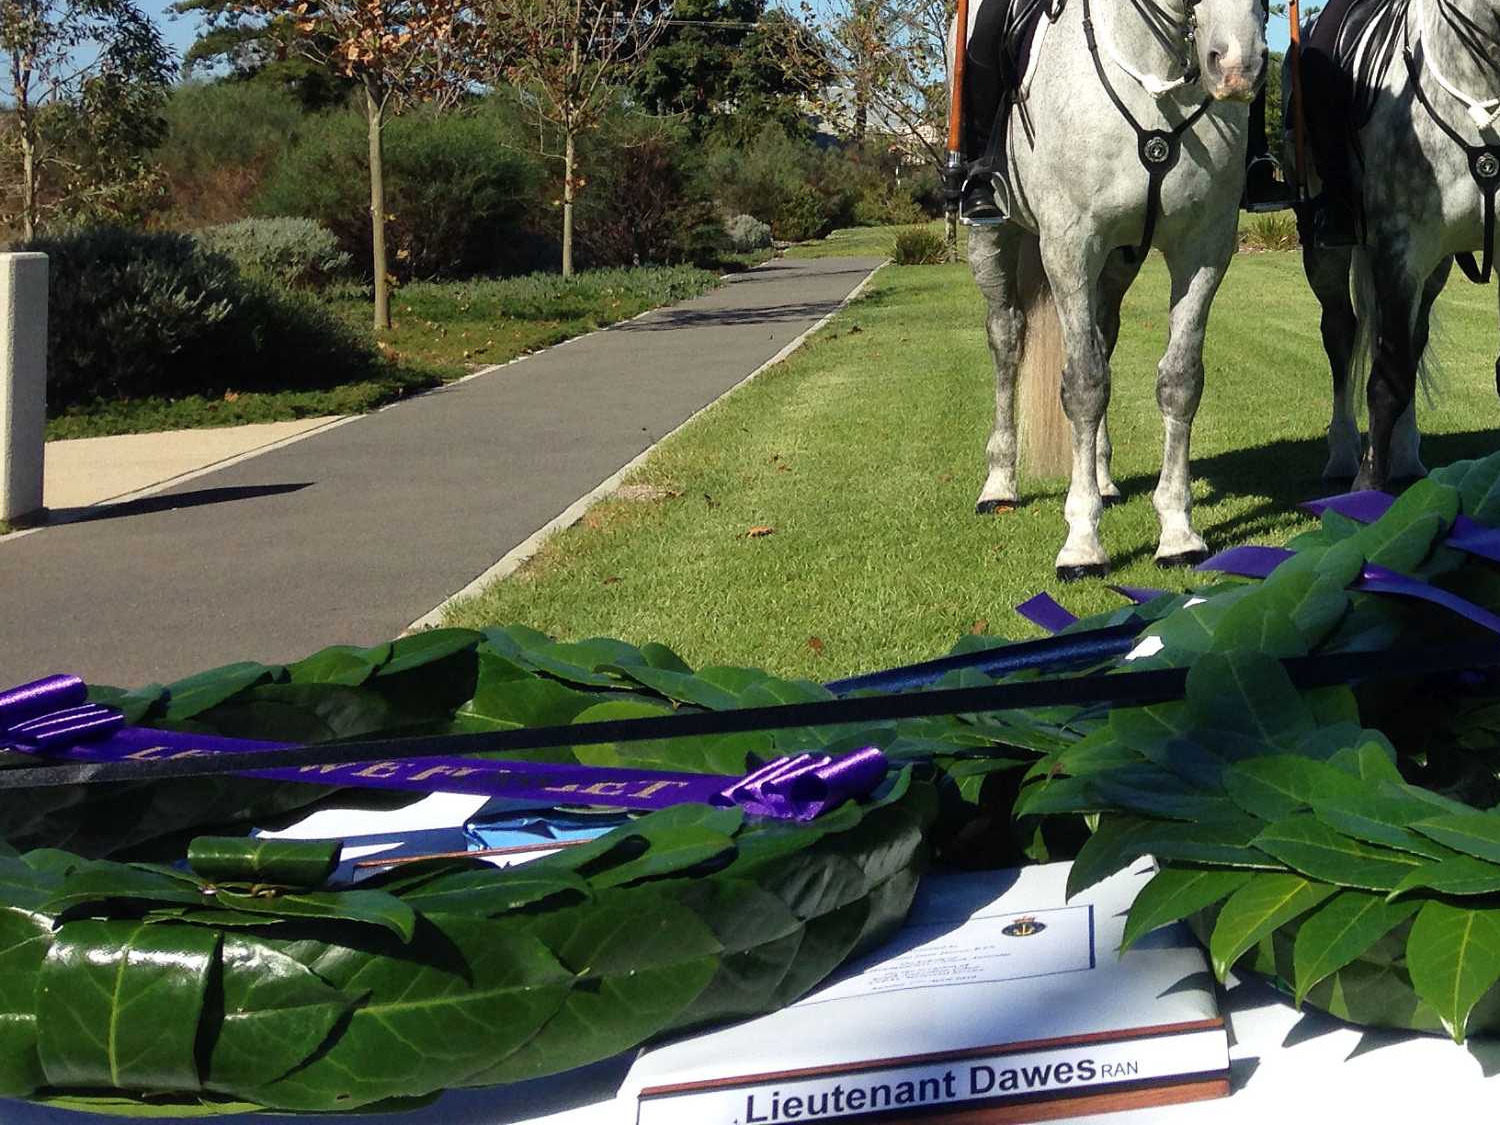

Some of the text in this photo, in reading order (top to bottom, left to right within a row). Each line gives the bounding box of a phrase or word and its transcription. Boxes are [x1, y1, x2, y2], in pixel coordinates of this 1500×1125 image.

[746, 1059, 1139, 1124] Lieutenant Dawes RAN
